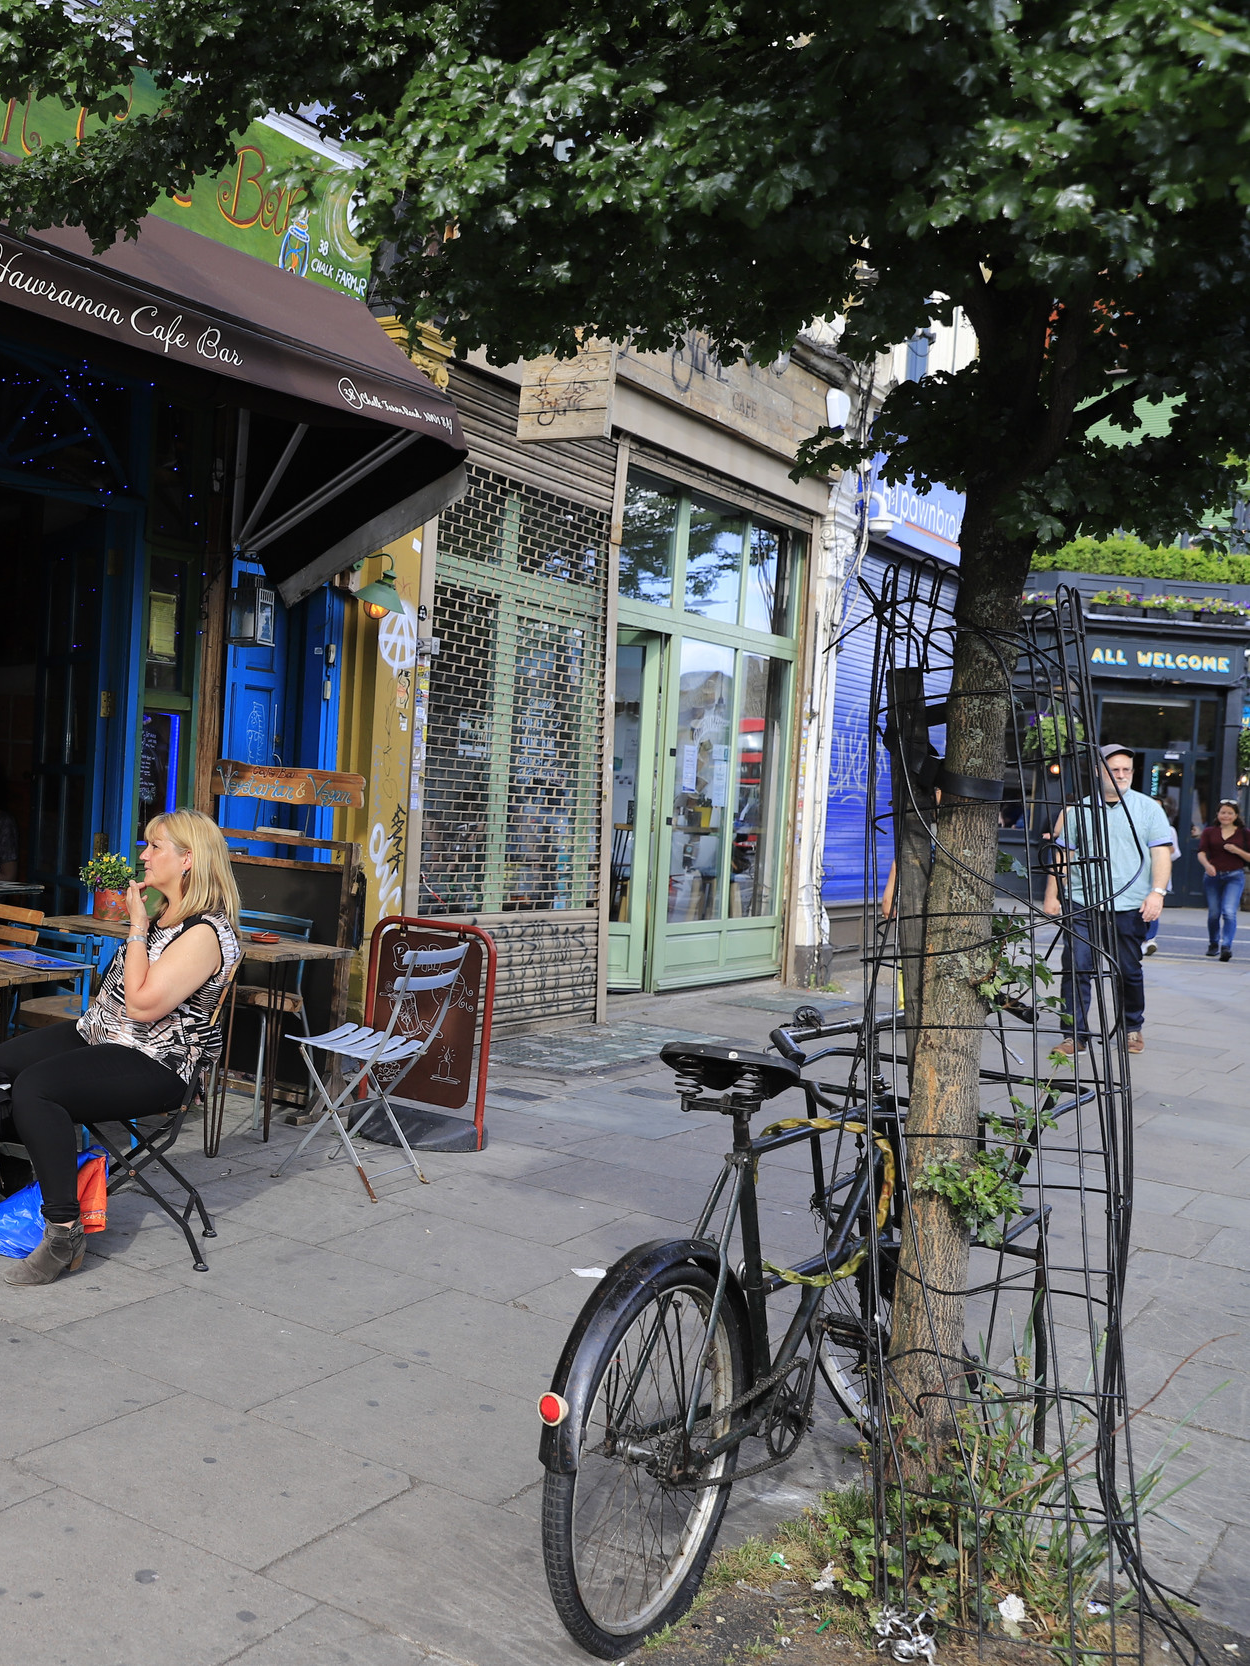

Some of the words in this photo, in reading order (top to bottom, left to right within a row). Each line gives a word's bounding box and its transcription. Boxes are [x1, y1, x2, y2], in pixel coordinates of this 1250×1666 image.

[318, 239, 329, 256] 38
[310, 258, 335, 279] CHALK
[130, 305, 190, 353] Cafe
[196, 325, 244, 367] Bar
[732, 391, 758, 420] CAFE
[1091, 647, 1129, 666] ALL
[1136, 650, 1230, 674] WELCOME
[215, 765, 294, 801] Vegetarian
[295, 781, 306, 799] &
[306, 773, 353, 808] Vegan
[252, 766, 276, 780] Cafe
